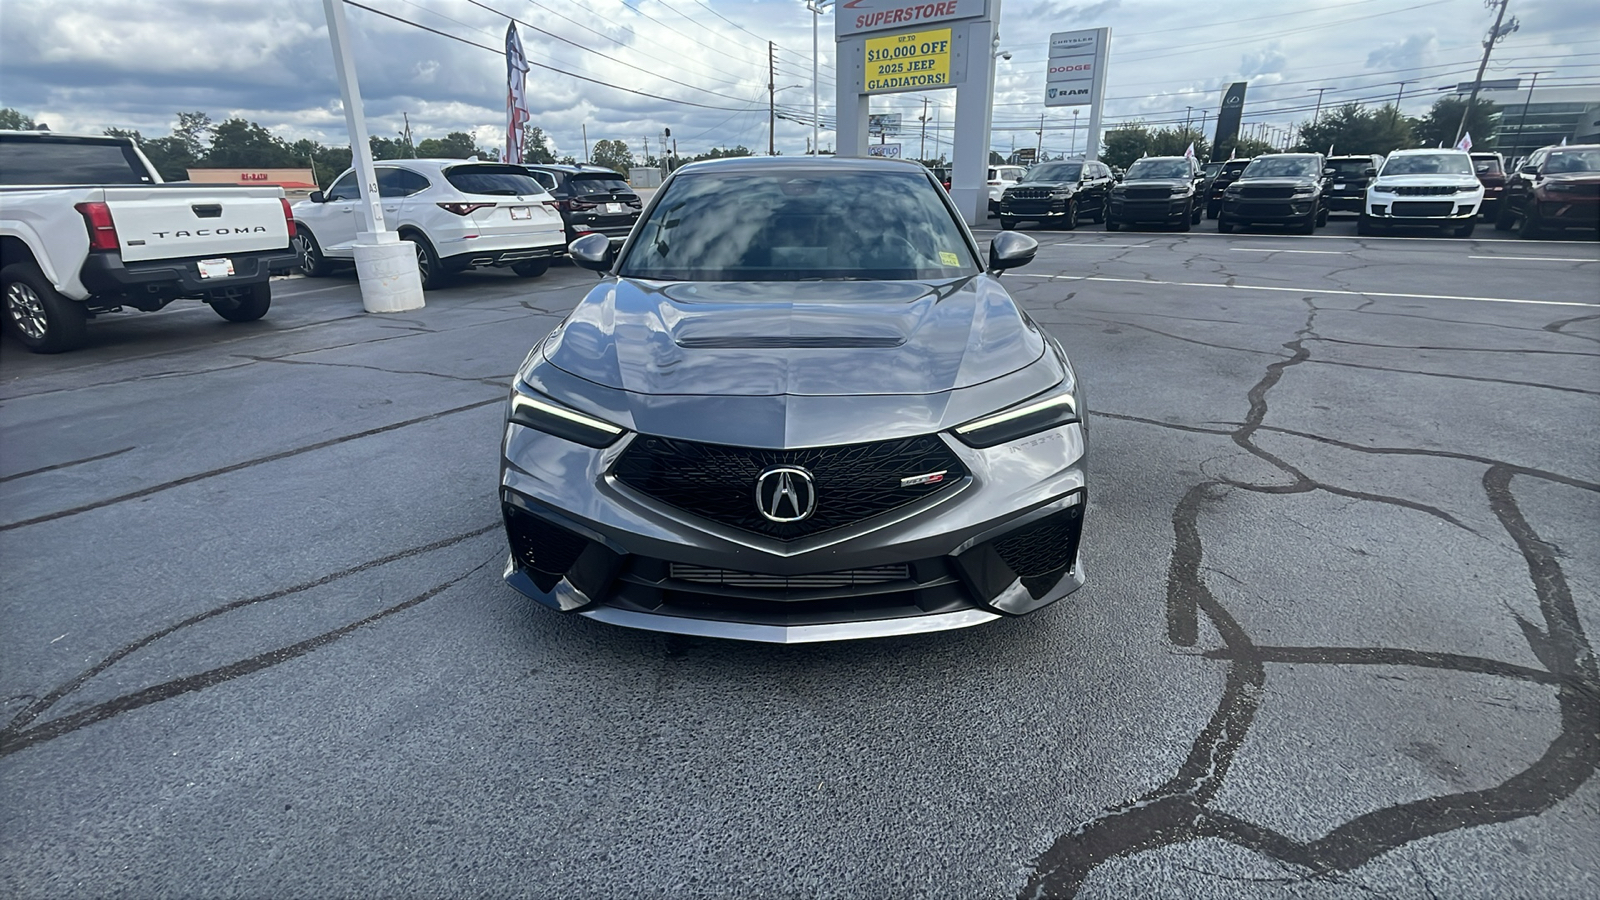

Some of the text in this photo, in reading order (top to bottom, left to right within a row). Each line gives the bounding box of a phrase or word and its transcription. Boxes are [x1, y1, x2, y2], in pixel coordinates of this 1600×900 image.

[855, 1, 957, 28] SUPERSTORE
[1052, 37, 1093, 45] CHRYSLER
[868, 41, 947, 61] $10,000 OFF
[878, 60, 935, 74] 2025 JEEP
[1049, 64, 1091, 73] DODGE
[868, 73, 945, 89] GLADIATORS!
[369, 182, 378, 193] A3
[152, 226, 266, 238] TACOMA
